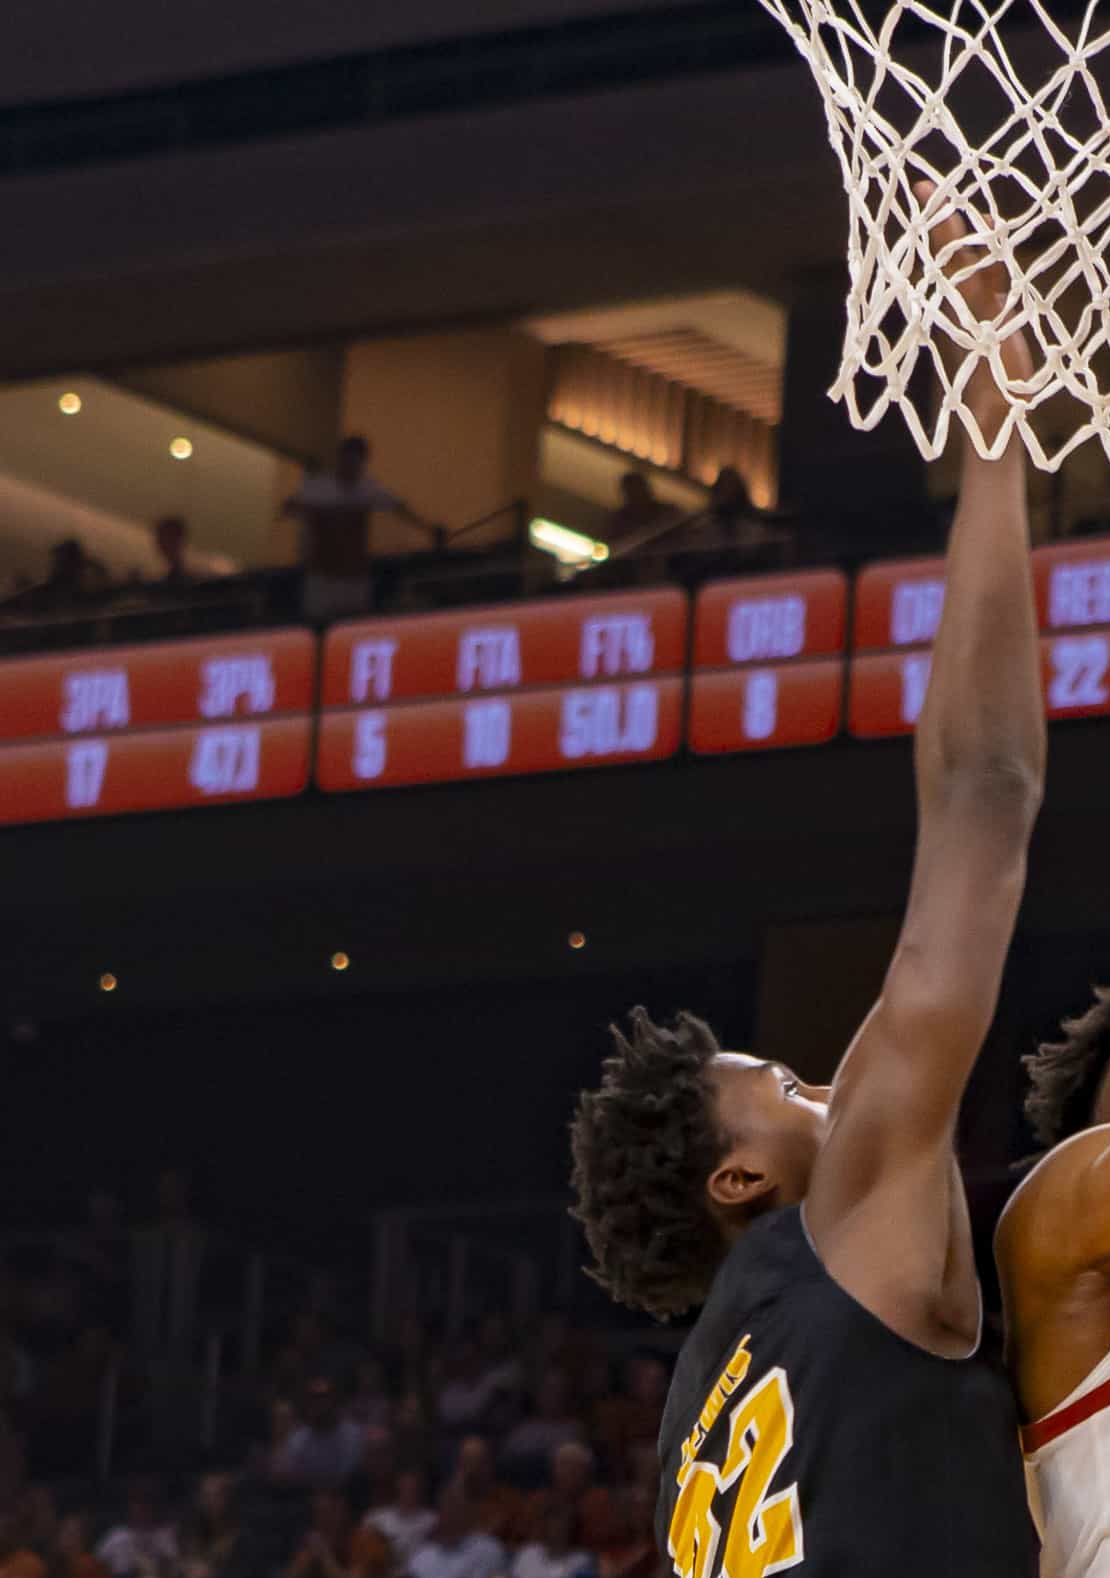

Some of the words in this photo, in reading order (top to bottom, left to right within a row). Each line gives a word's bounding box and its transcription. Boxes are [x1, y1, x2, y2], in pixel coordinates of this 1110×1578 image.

[892, 580, 945, 645] DR
[352, 637, 398, 703] FT
[457, 625, 521, 692] FTA
[1049, 634, 1110, 709] 22
[65, 737, 109, 808] 17
